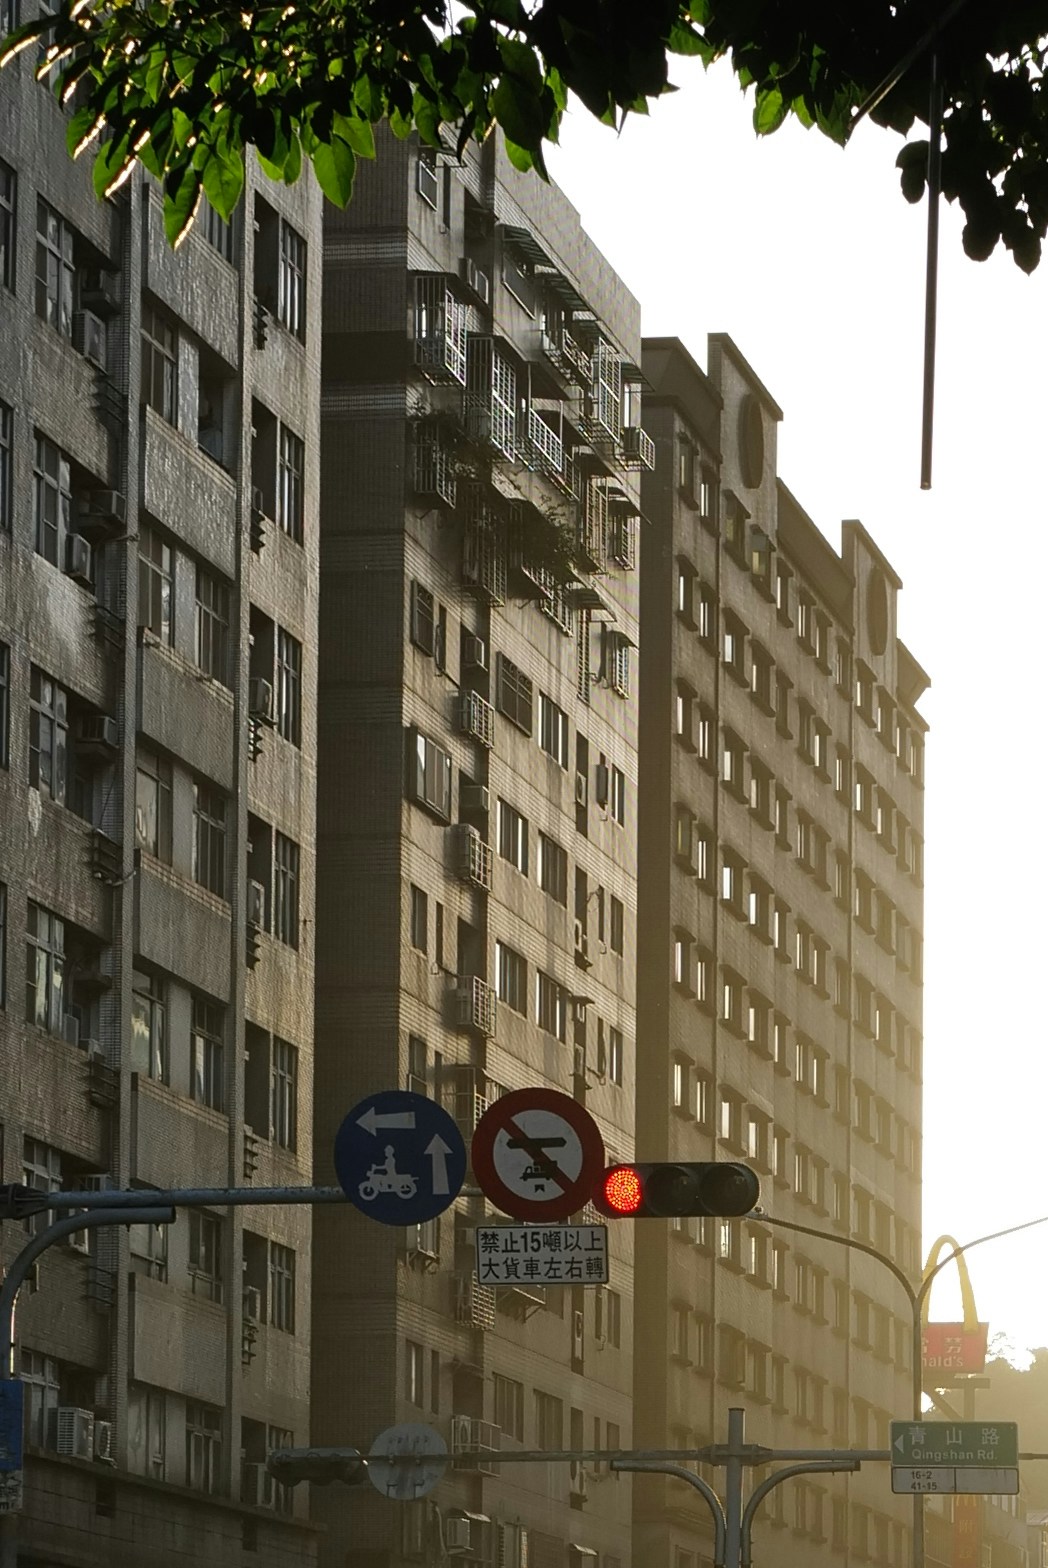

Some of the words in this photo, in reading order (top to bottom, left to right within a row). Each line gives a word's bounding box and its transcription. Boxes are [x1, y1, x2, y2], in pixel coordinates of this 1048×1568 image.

[480, 1230, 604, 1253] 禁止15噸以上
[481, 1256, 605, 1279] 大貨車左右轉
[908, 1426, 1000, 1445] 青山路
[911, 1448, 973, 1461] Qingshan
[977, 1449, 998, 1460] Rd.
